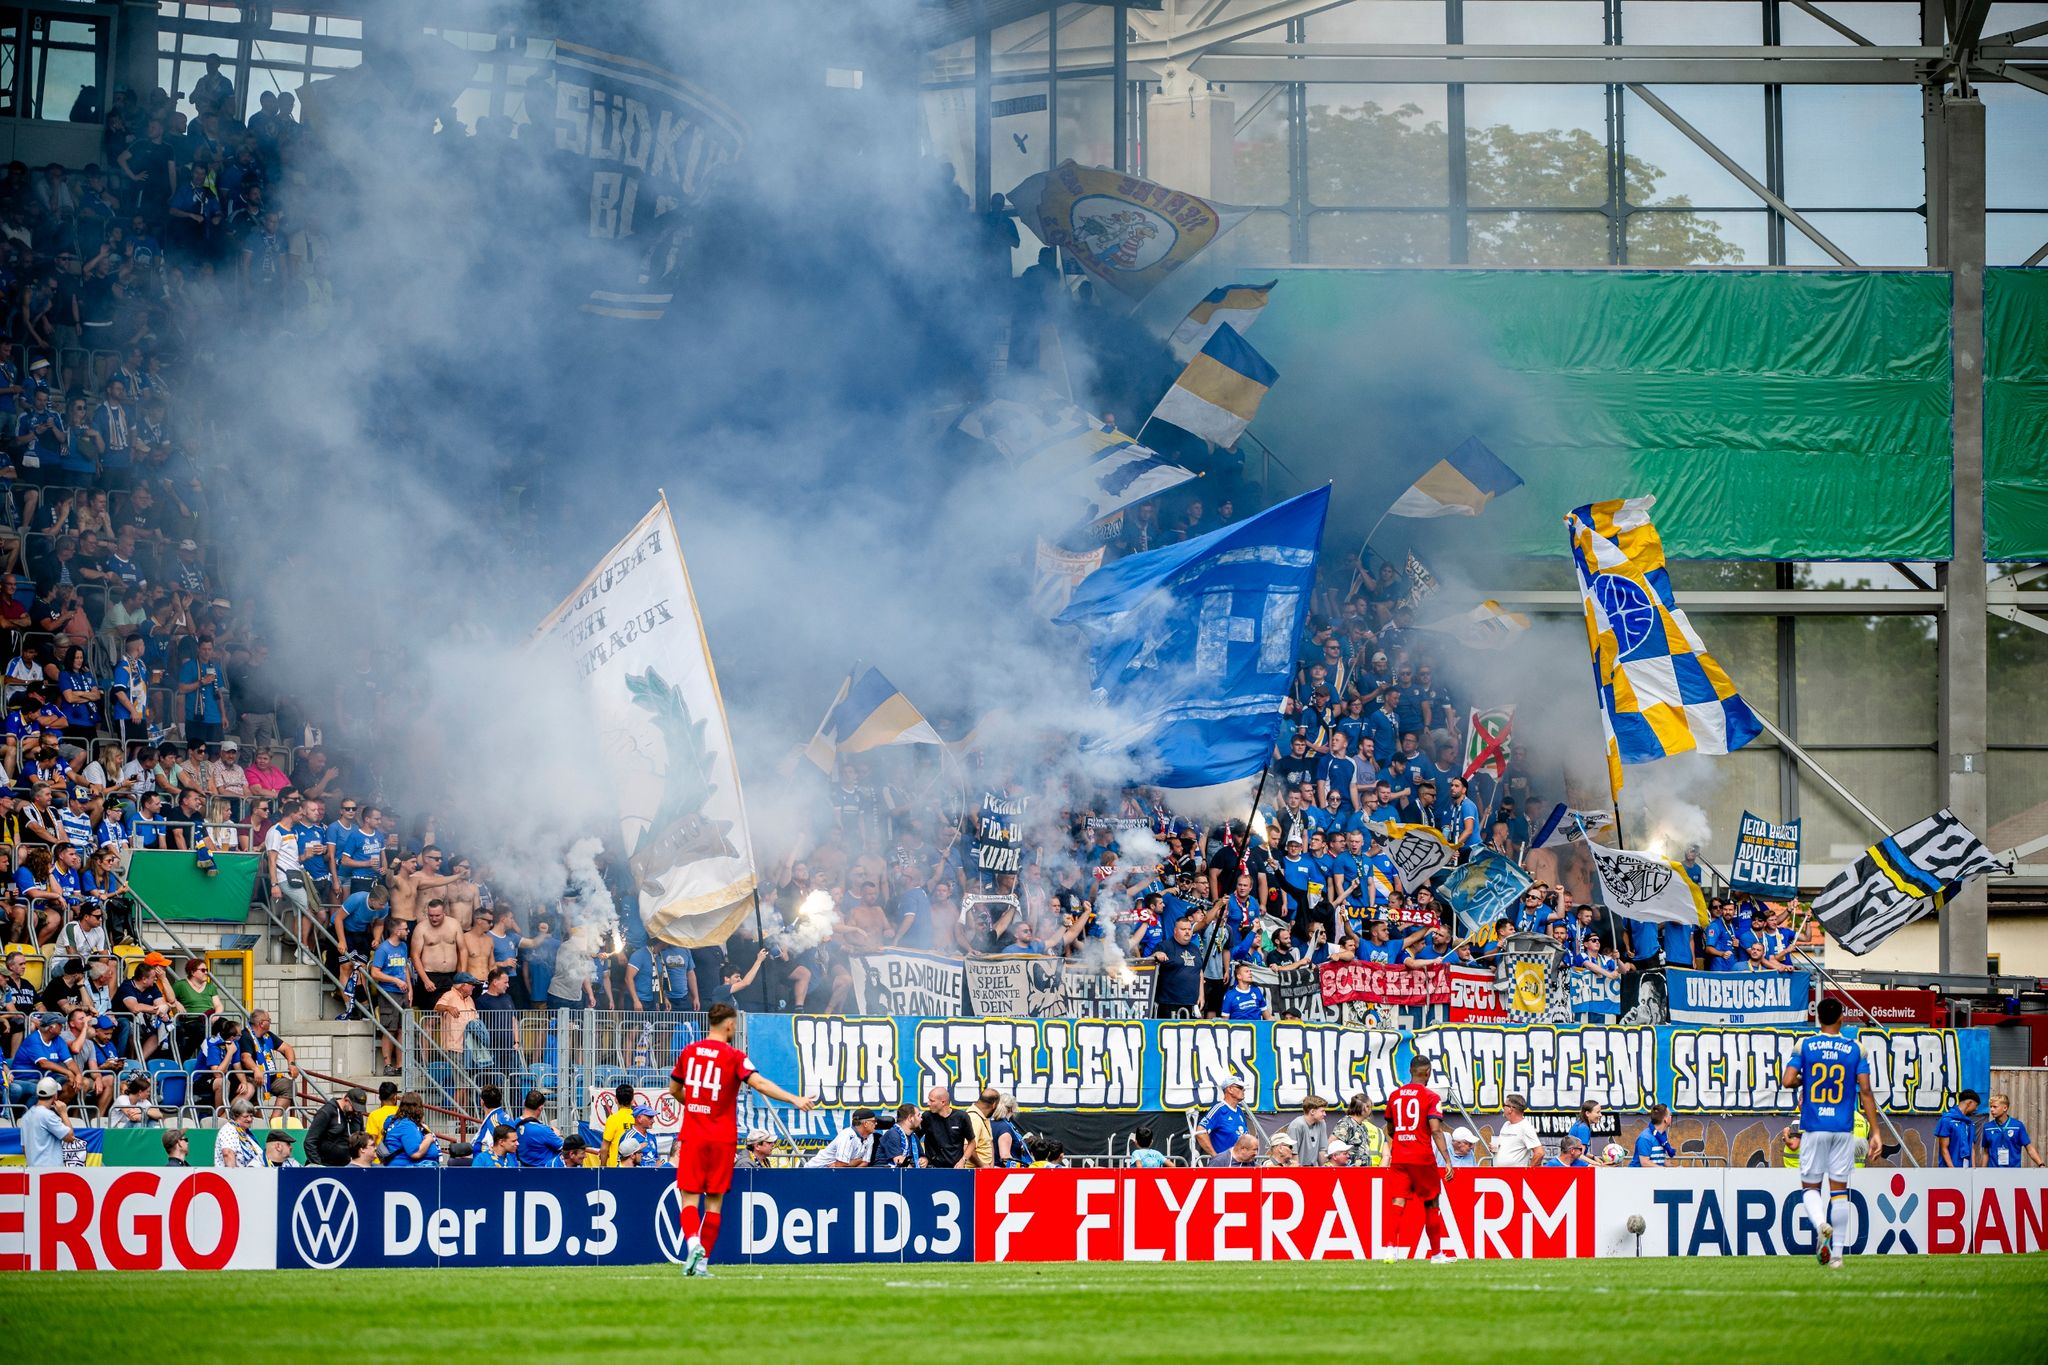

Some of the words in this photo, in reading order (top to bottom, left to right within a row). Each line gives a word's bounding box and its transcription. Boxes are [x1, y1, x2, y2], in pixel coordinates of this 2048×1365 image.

[1737, 843, 1798, 867] ADOLESCENT
[1732, 859, 1797, 888] CREW
[888, 961, 962, 999] BAMBULE
[968, 965, 1001, 976] NUTZE
[1002, 964, 1021, 975] DAS
[978, 976, 1014, 989] SPIEL
[1321, 964, 1450, 998] SCHICKERIA
[982, 988, 1020, 1000] KÖNNTE
[1063, 973, 1151, 1000] REFUGEES
[1686, 977, 1791, 1010] UNBEUGSAM
[981, 1000, 1013, 1014] DEIN
[1063, 999, 1150, 1020] WELCOME
[1729, 1014, 1744, 1025] UND
[1871, 1005, 1916, 1019] Göschwitz
[685, 1056, 722, 1102] 44
[794, 1017, 902, 1109] WIR
[916, 1018, 1145, 1111] STELLEN
[1160, 1022, 1258, 1112] UNS
[1273, 1022, 1403, 1112] EUCH
[1810, 1062, 1846, 1105] 23
[1393, 1097, 1420, 1132] 19
[0, 1171, 240, 1271] ERGO
[384, 1190, 486, 1257] Der
[503, 1189, 618, 1257] ID.3
[741, 1190, 838, 1256] Der
[854, 1189, 962, 1256] ID.3
